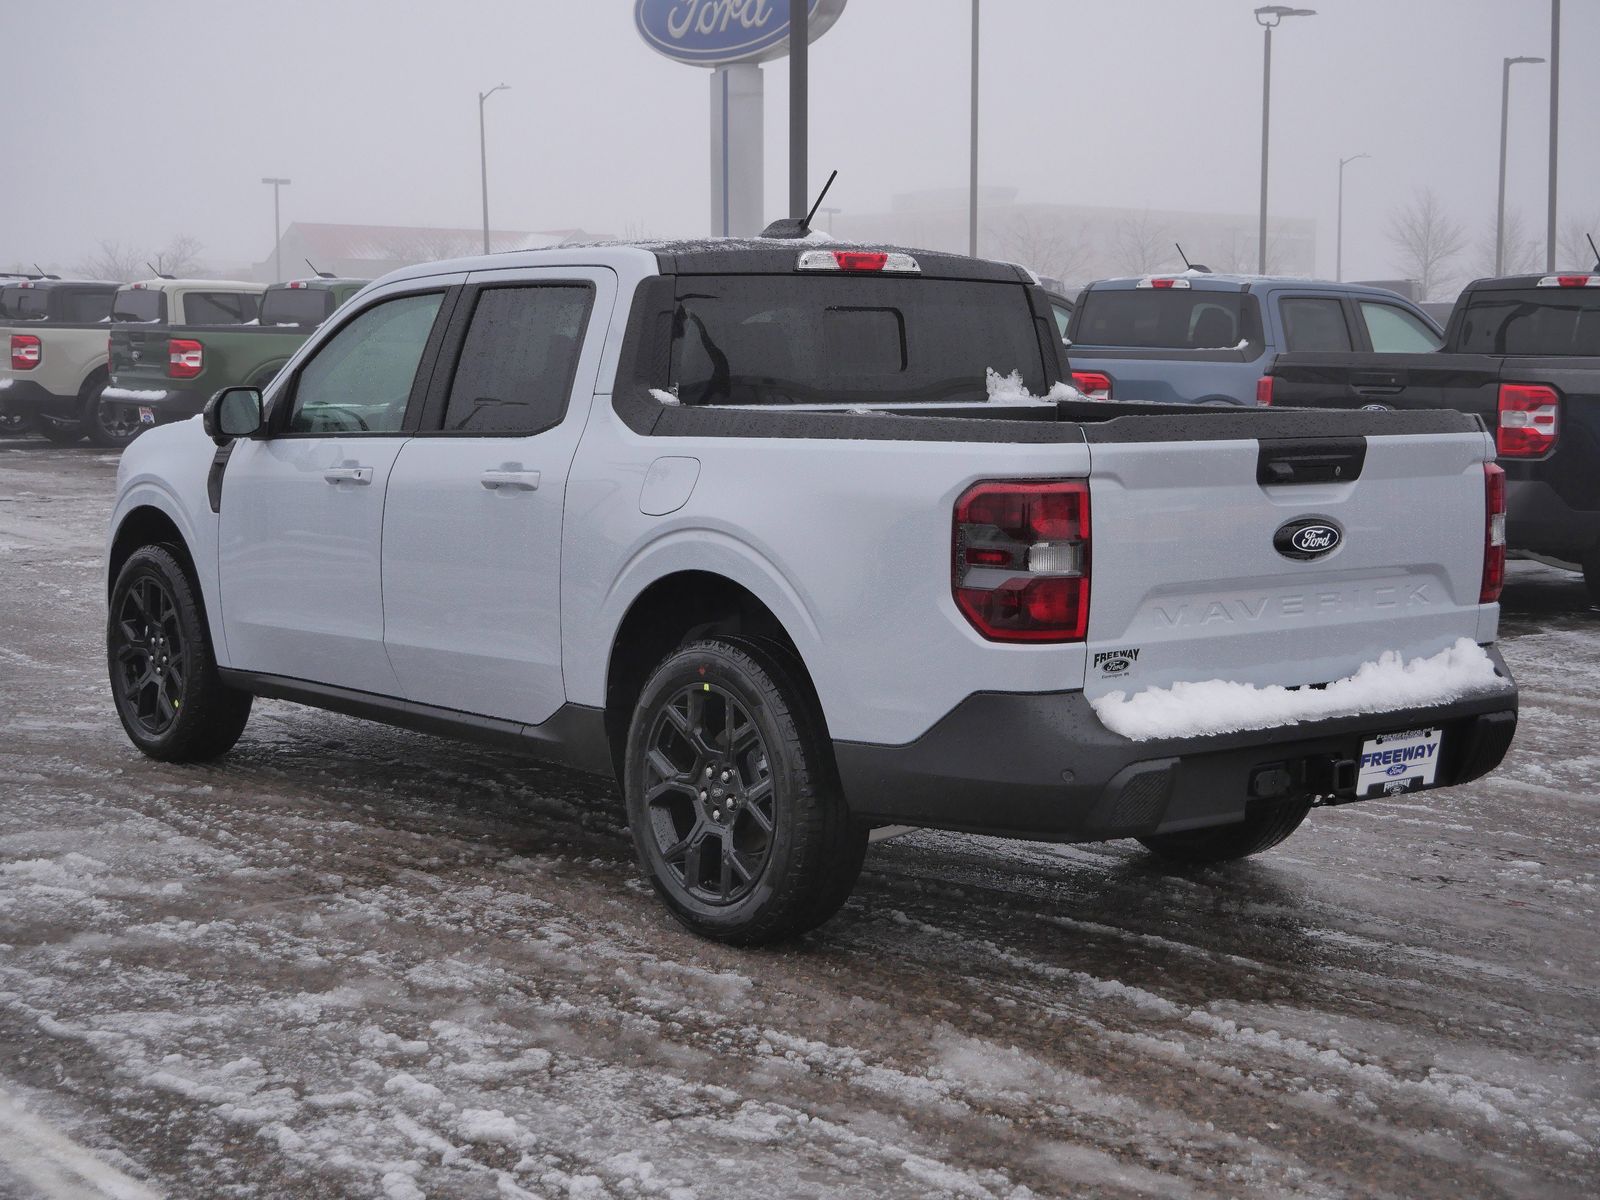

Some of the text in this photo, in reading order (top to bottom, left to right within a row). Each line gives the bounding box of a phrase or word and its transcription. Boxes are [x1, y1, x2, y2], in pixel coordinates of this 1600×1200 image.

[1301, 529, 1331, 548] Ford
[1152, 584, 1430, 630] MAVERICK
[1093, 648, 1140, 669] FREEWAY
[1360, 743, 1438, 769] FREEWAY
